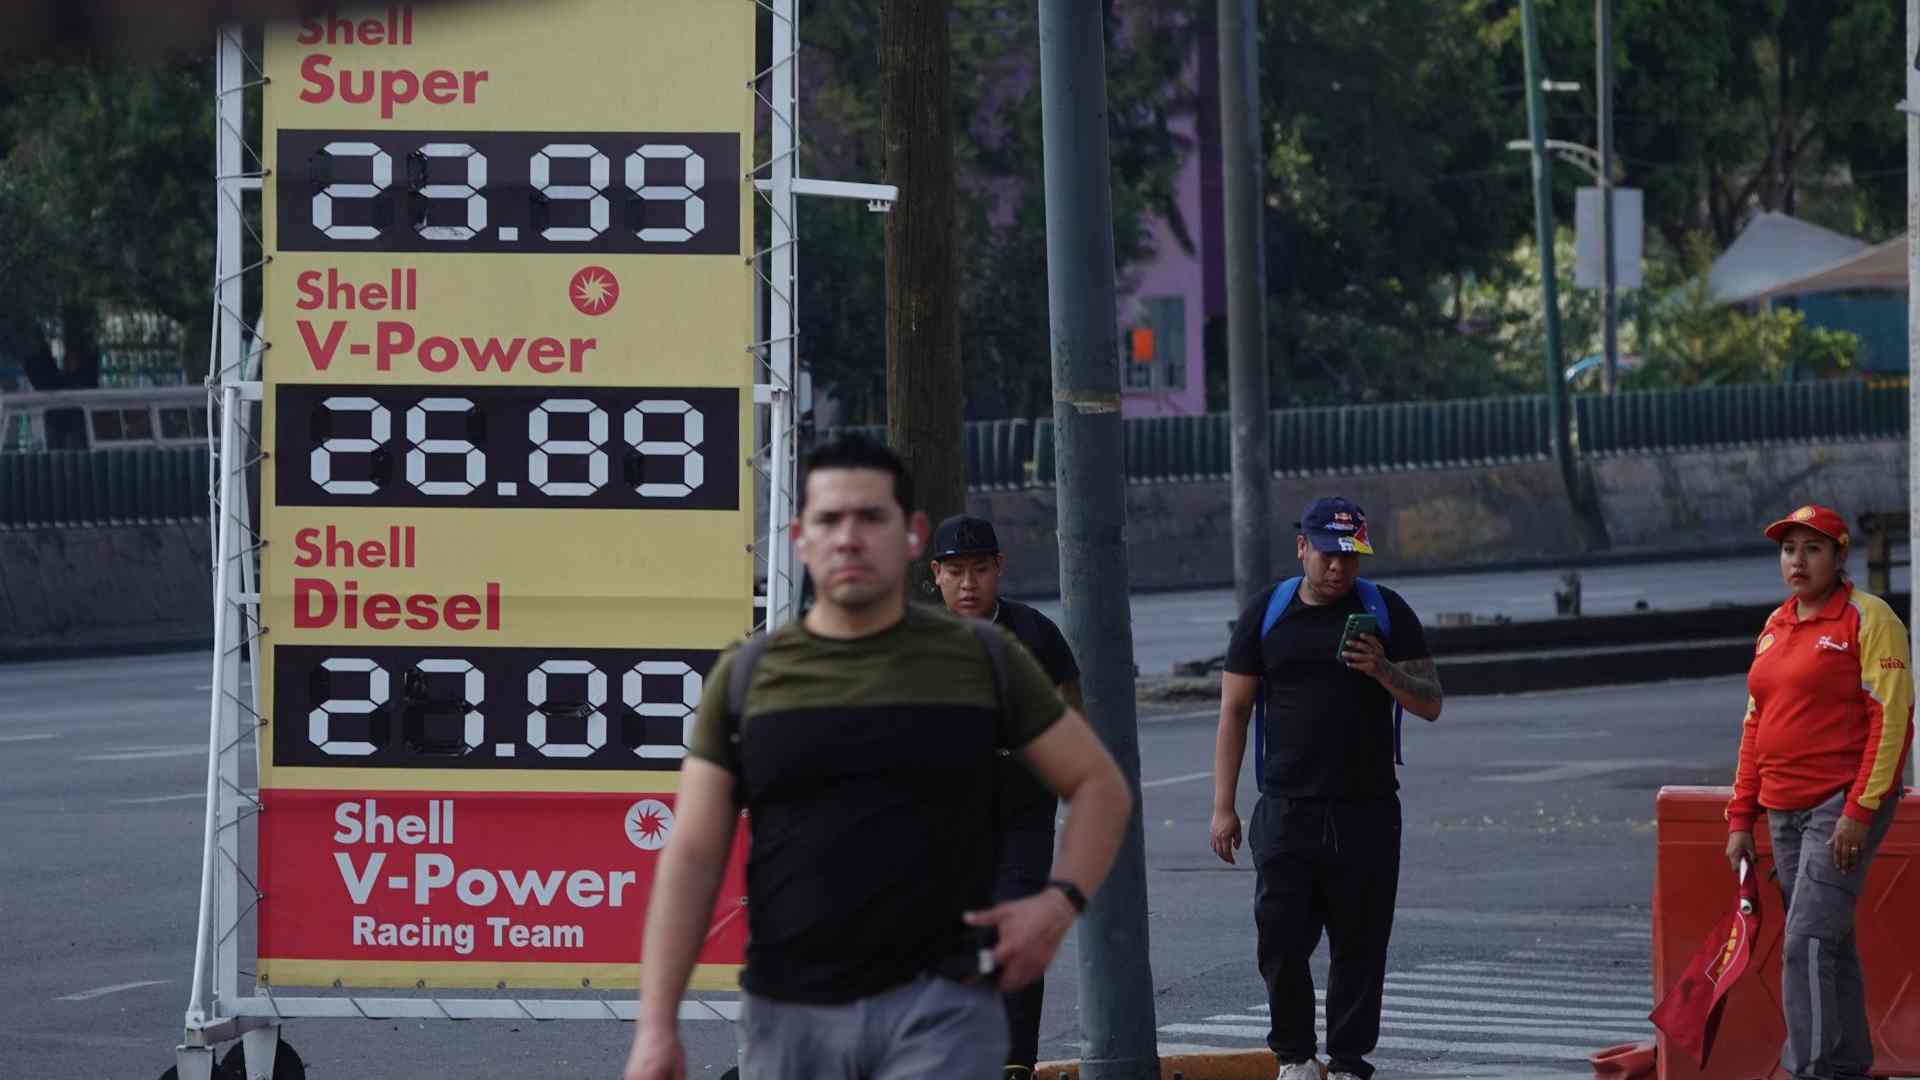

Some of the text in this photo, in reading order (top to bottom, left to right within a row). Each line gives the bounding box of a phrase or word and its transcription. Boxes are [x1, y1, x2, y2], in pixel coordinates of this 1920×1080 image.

[296, 7, 413, 46] Shell
[300, 53, 489, 119] Super
[312, 142, 705, 242] 23.99
[296, 267, 416, 311] Shell
[297, 319, 597, 374] V-Power
[311, 397, 704, 498] 26.89
[294, 525, 415, 568] Shell
[293, 577, 500, 632] Diesel
[309, 658, 703, 758] 27.09
[334, 799, 454, 845] Shell
[334, 852, 636, 907] V-Power
[352, 915, 584, 954] Racing Team
